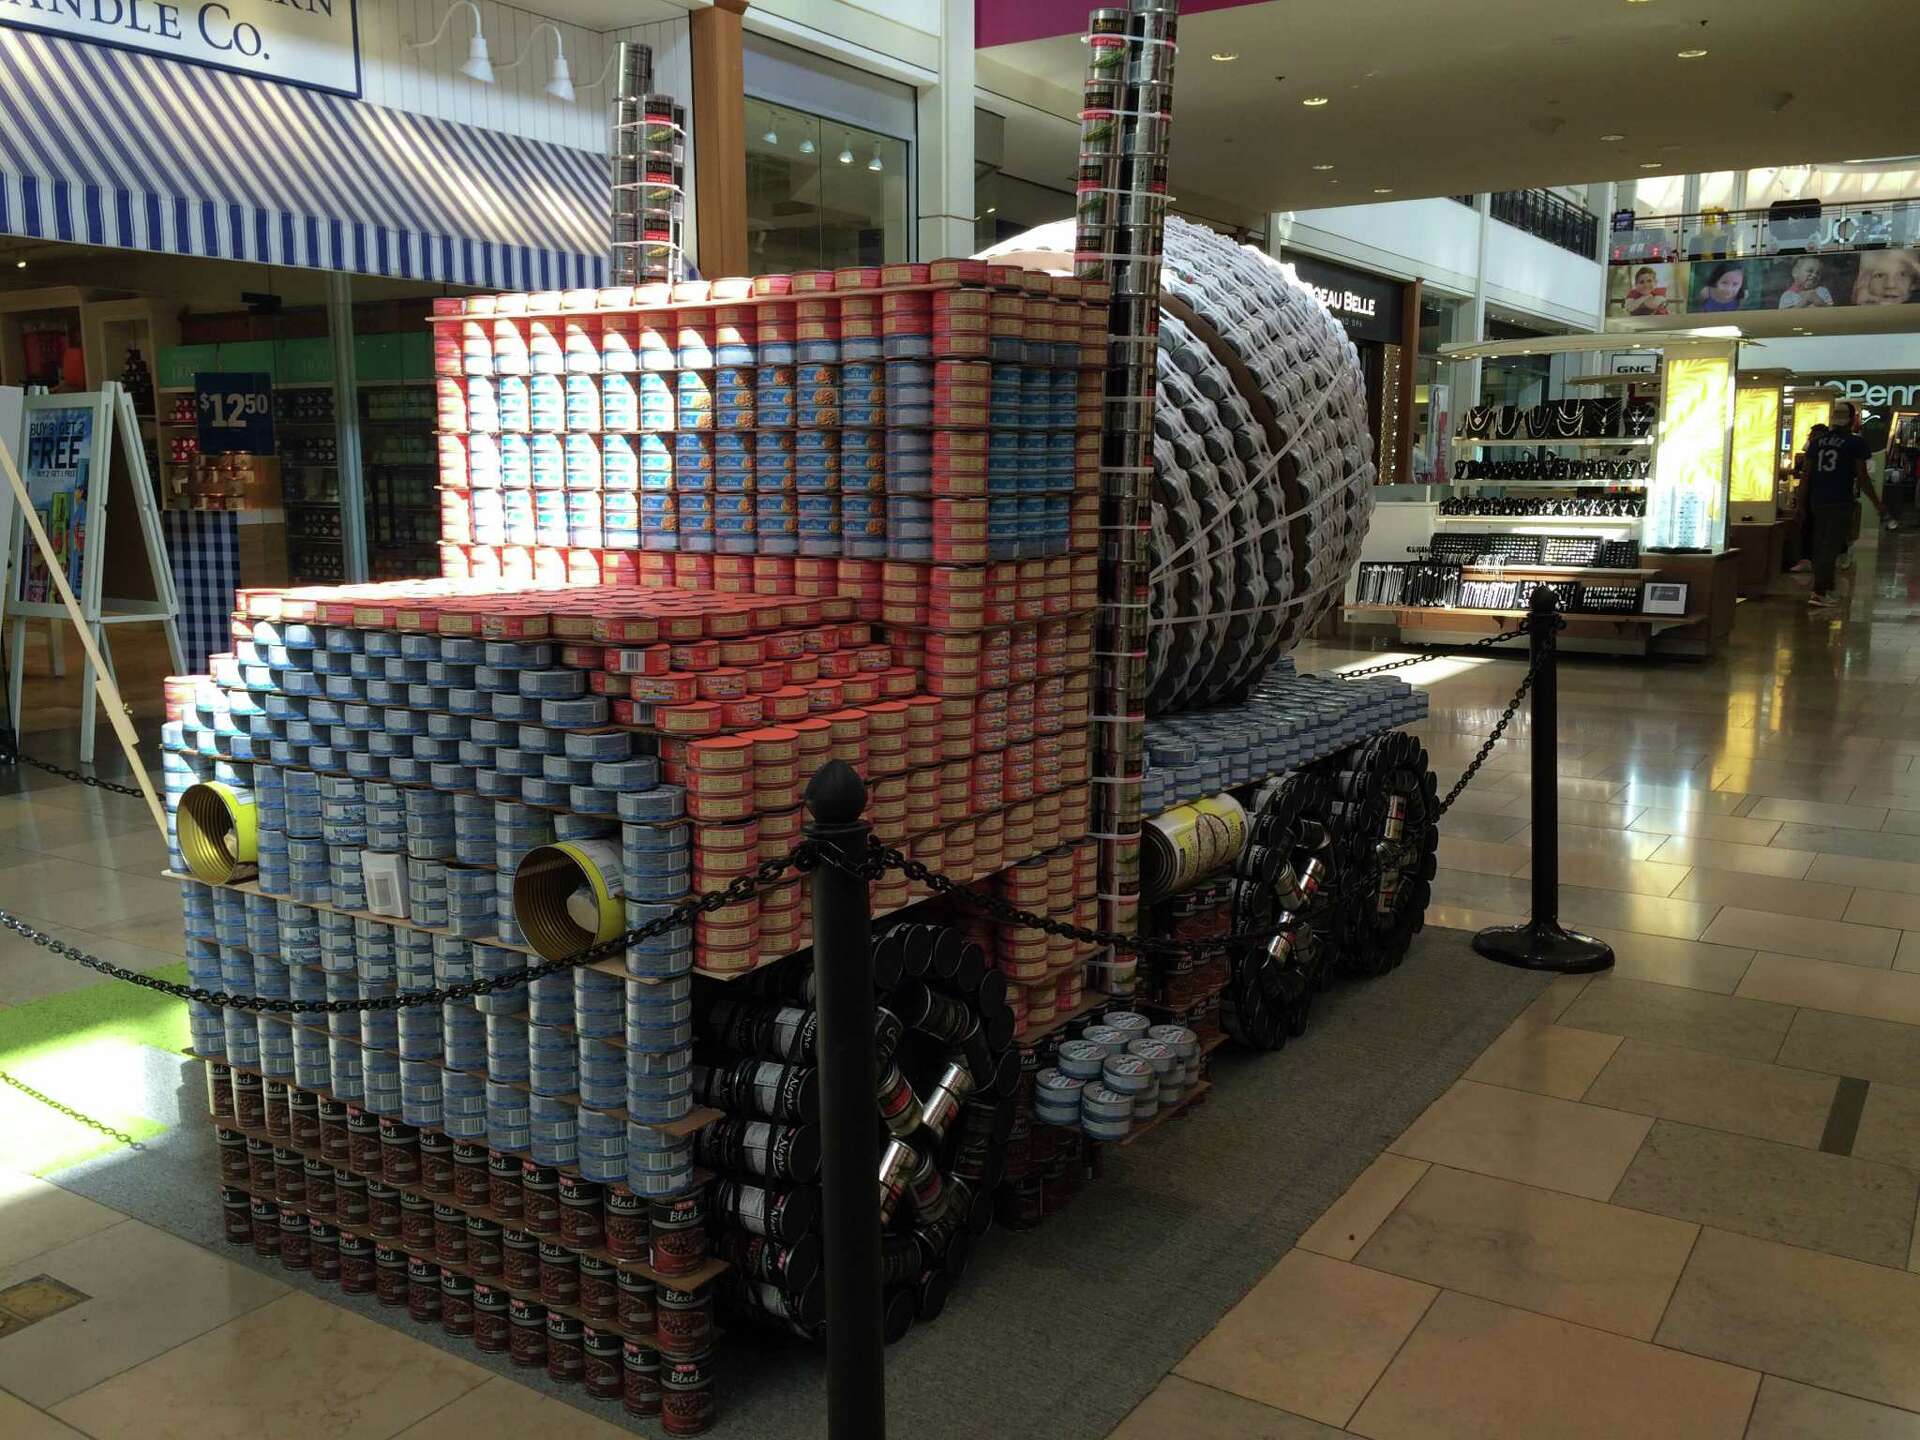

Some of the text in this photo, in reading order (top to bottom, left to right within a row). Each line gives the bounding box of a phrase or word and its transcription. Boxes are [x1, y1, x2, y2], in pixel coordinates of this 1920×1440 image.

[1616, 365, 1652, 374] GNC
[1815, 379, 1920, 406] Penn
[29, 422, 47, 436] BUY
[59, 421, 75, 435] GET
[77, 420, 85, 434] 2
[28, 435, 84, 470] FREE
[1817, 448, 1838, 472] 13
